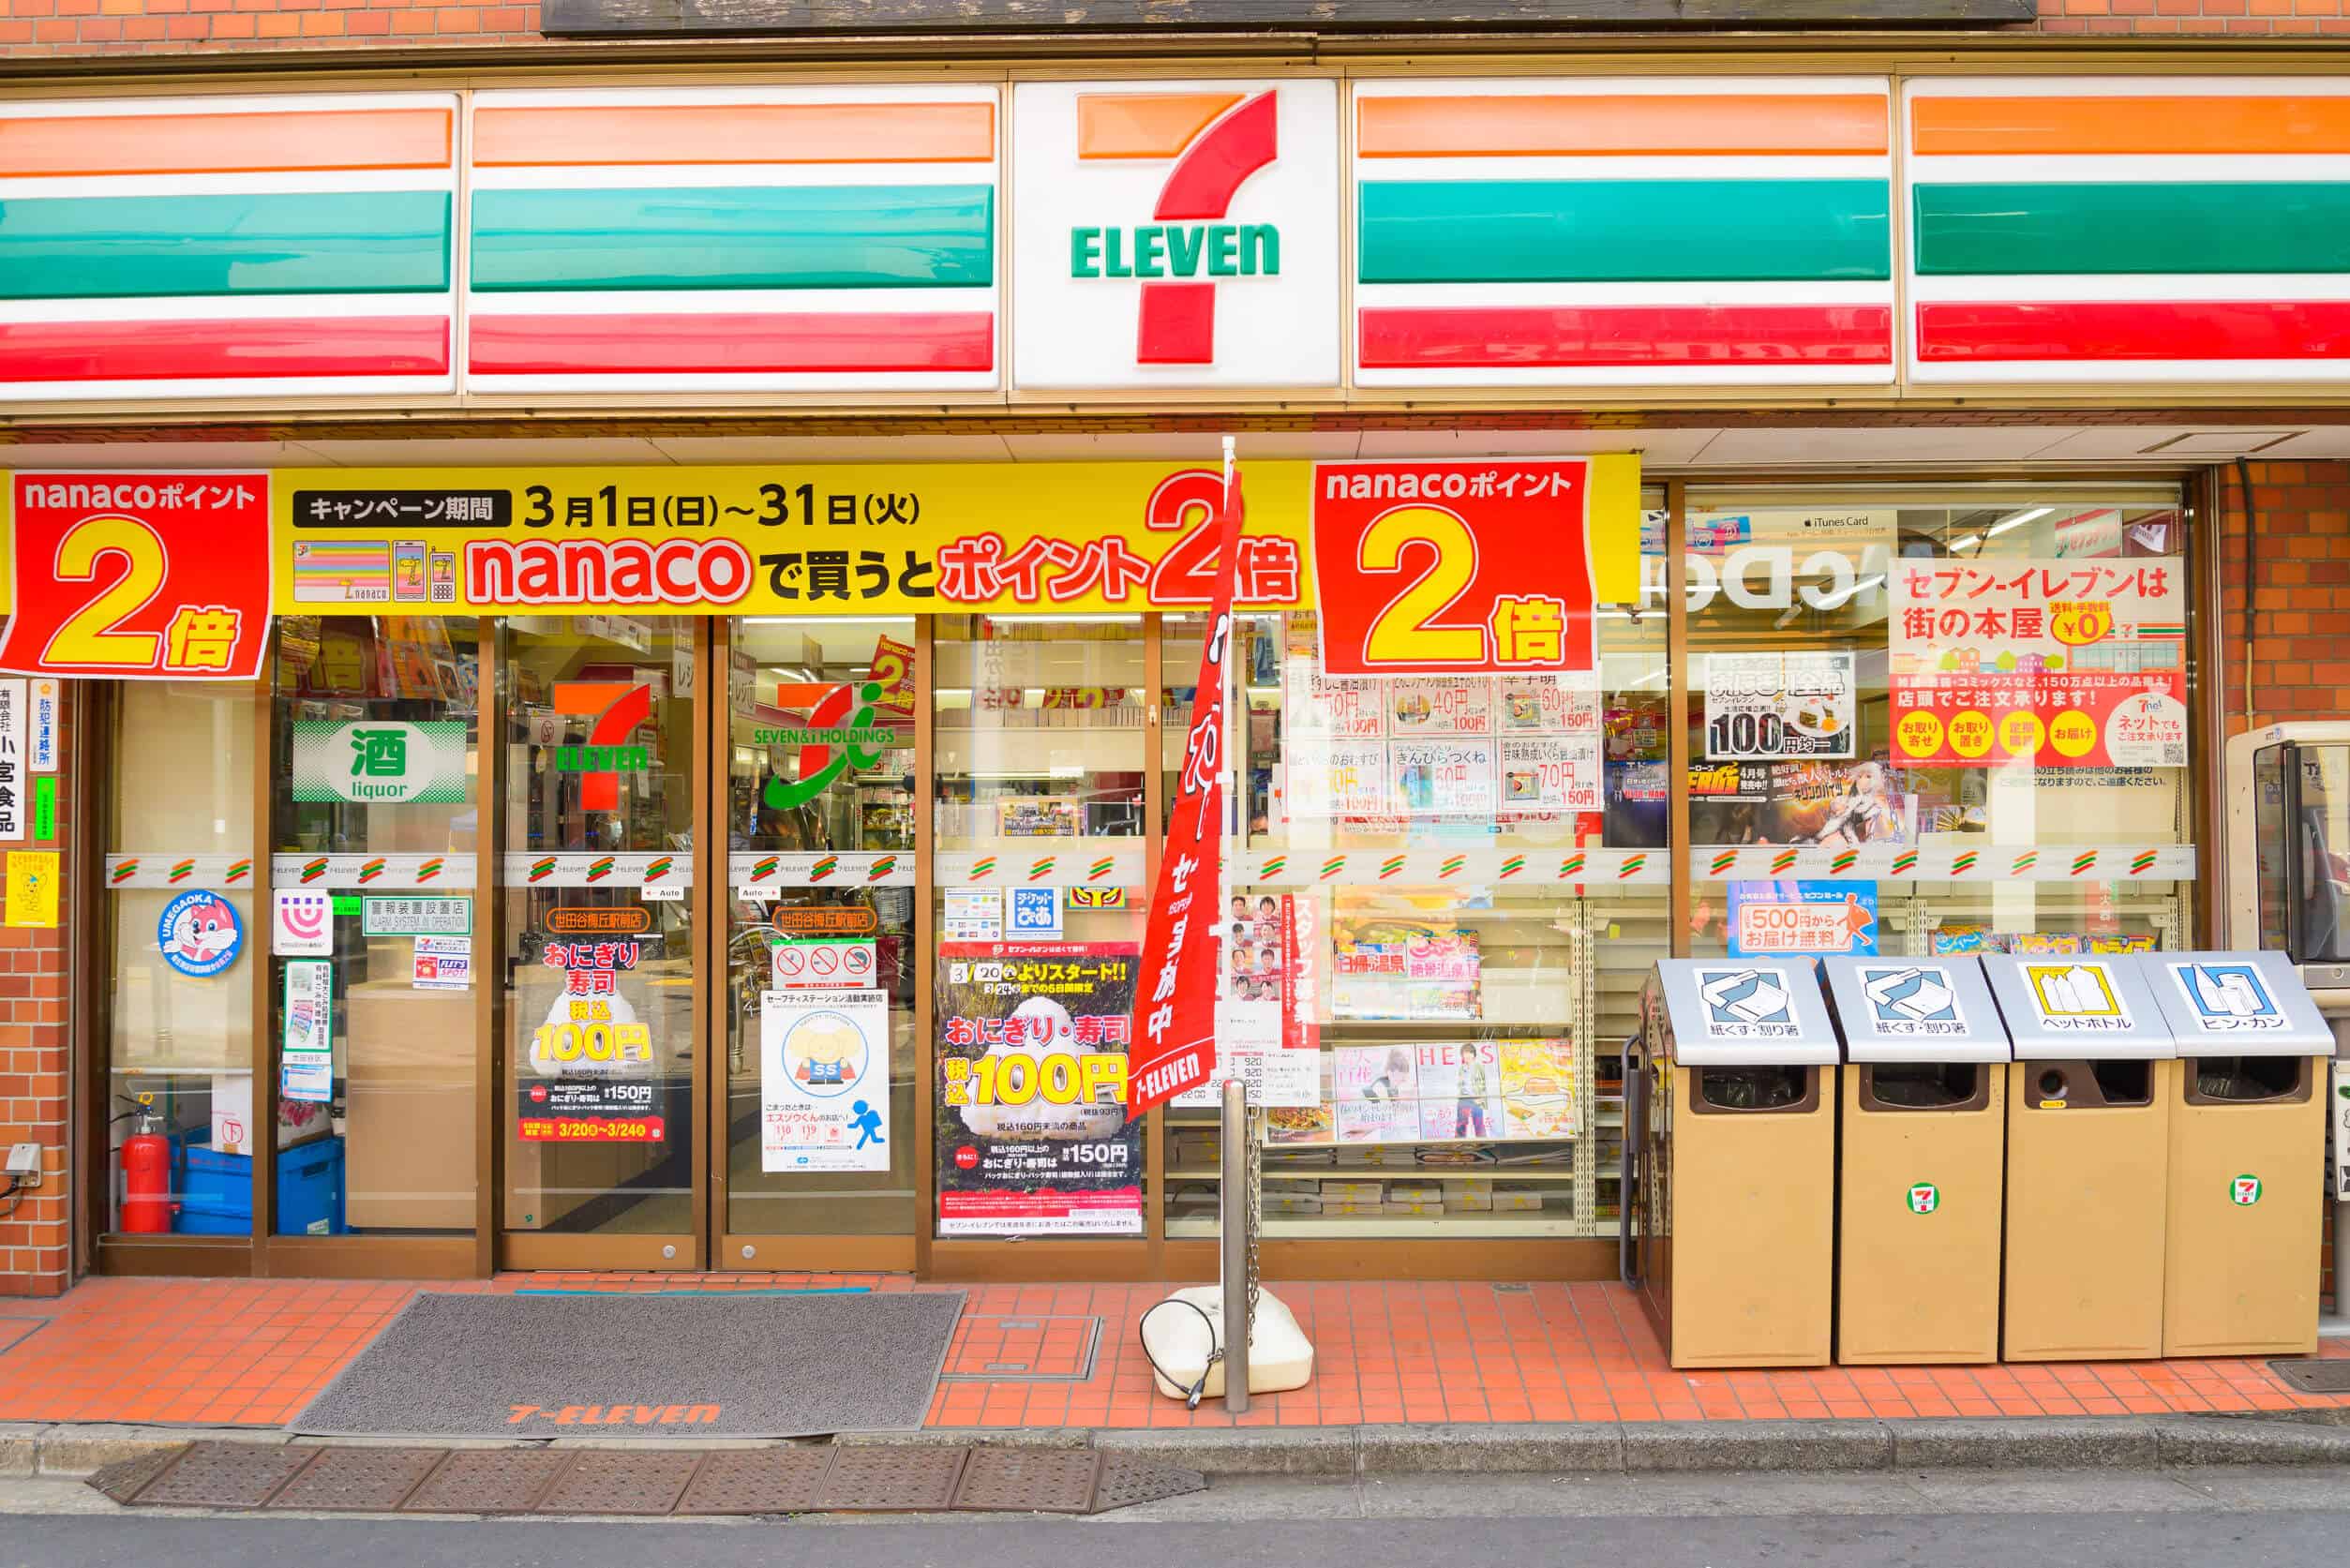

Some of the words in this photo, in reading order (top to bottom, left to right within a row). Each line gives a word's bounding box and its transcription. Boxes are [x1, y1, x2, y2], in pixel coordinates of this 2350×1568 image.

[309, 497, 493, 521] キャンペーン期間
[1814, 515, 1845, 527] iTunes
[1847, 515, 1868, 526] Card
[1903, 606, 2043, 639] 街の本屋
[819, 728, 894, 744] HOLDINGS
[1903, 722, 1938, 734] お取り
[1953, 722, 1988, 734] お取り
[2054, 727, 2093, 740] お届け
[1908, 736, 1934, 748] 寄せ
[350, 727, 408, 777] 酒
[352, 780, 409, 800] liquor
[660, 889, 681, 897] Auto
[742, 889, 763, 897] Auto
[1745, 930, 1835, 947] お届け無料
[543, 942, 640, 969] おにぎり
[566, 969, 618, 995] 寿司
[569, 1001, 612, 1021] 税込
[945, 1015, 1131, 1046] おにぎり・寿司
[2201, 1017, 2284, 1030] ビン・カン
[533, 1023, 653, 1062] 100円
[1418, 1046, 1494, 1066] HES
[814, 1064, 838, 1076] SS
[971, 1053, 1129, 1105] 100円
